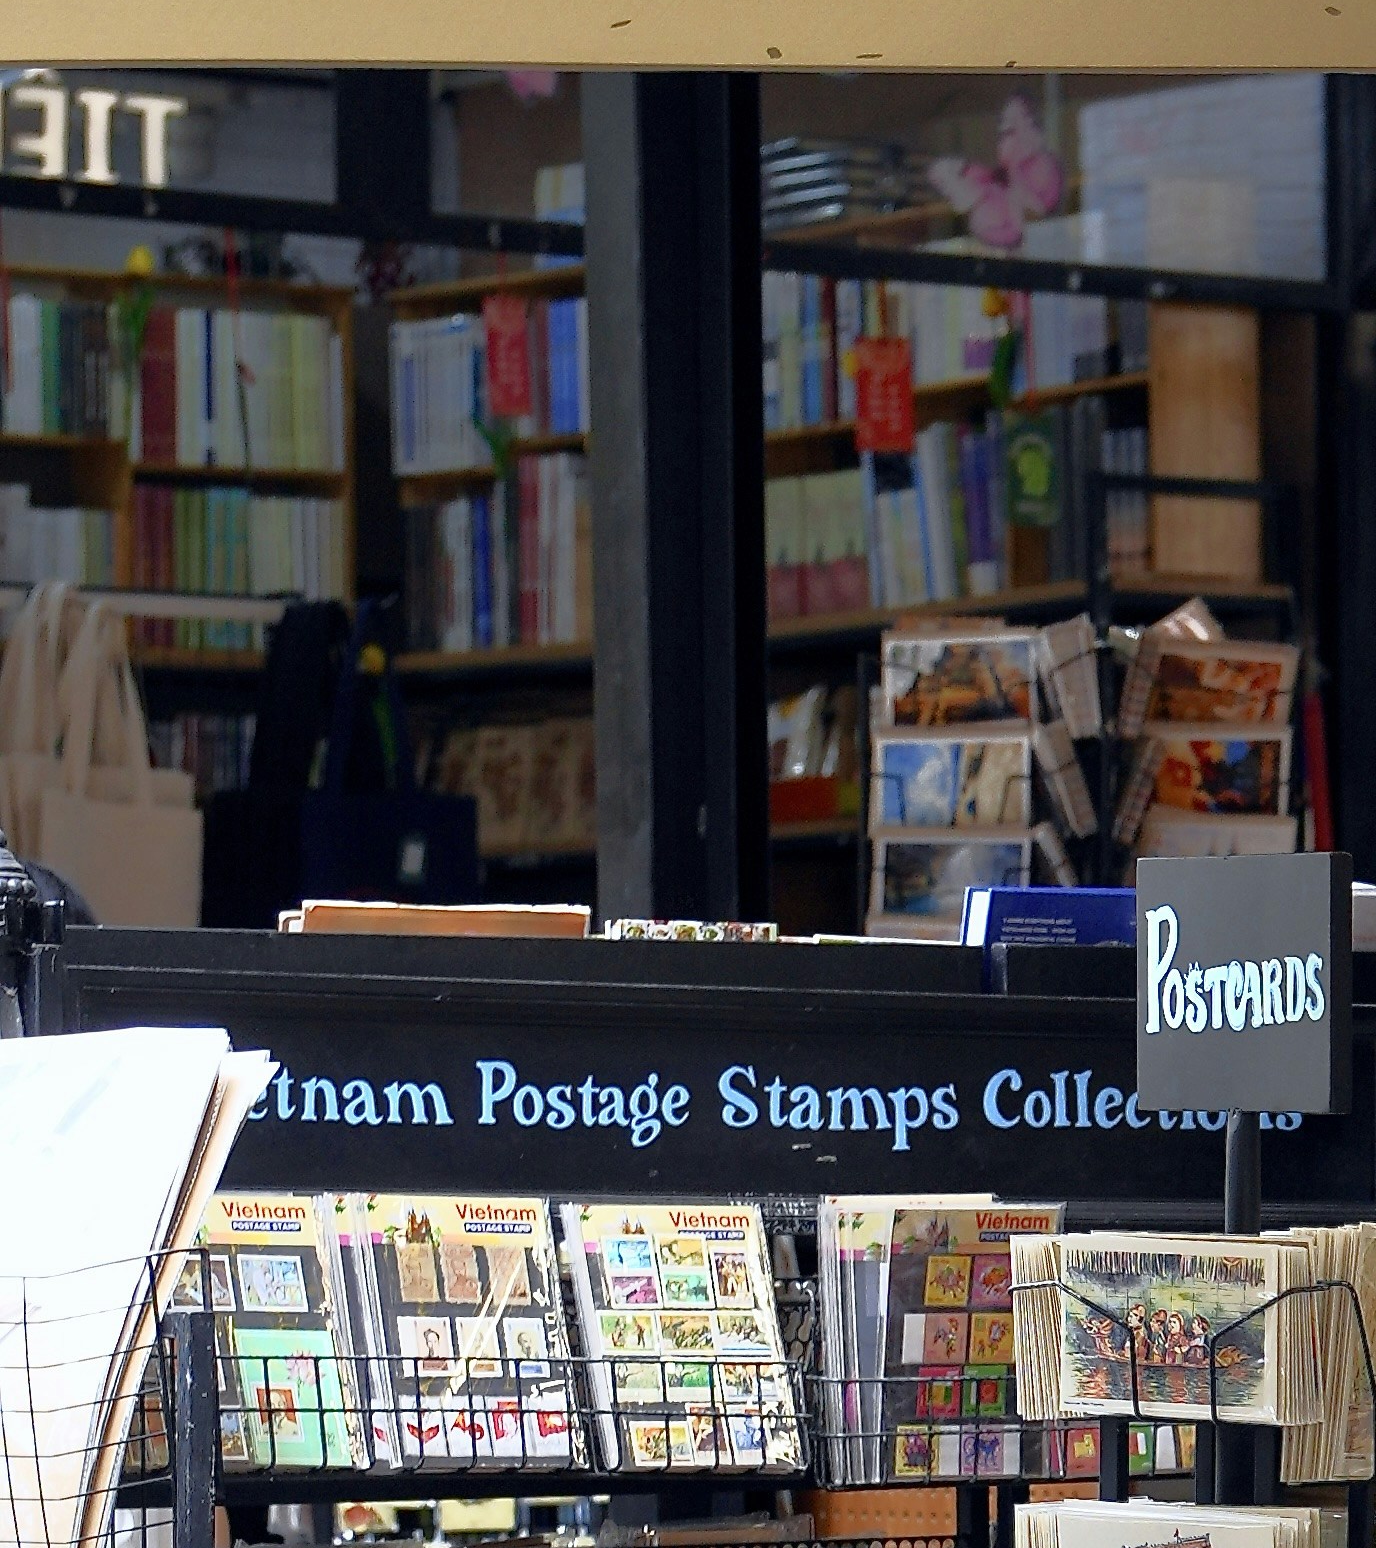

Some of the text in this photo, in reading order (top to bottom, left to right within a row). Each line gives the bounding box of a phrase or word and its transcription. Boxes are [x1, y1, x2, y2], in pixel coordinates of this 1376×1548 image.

[476, 1060, 691, 1147] Postage
[718, 1063, 960, 1153] Stamps
[222, 1202, 306, 1219] Vietnam
[456, 1204, 537, 1221] Vietnam
[232, 1222, 301, 1231] POSTAGE STAMP
[465, 1223, 532, 1233] POSTAGE STAMP
[670, 1211, 750, 1228] Vietnam
[976, 1212, 1050, 1229] Vietnam
